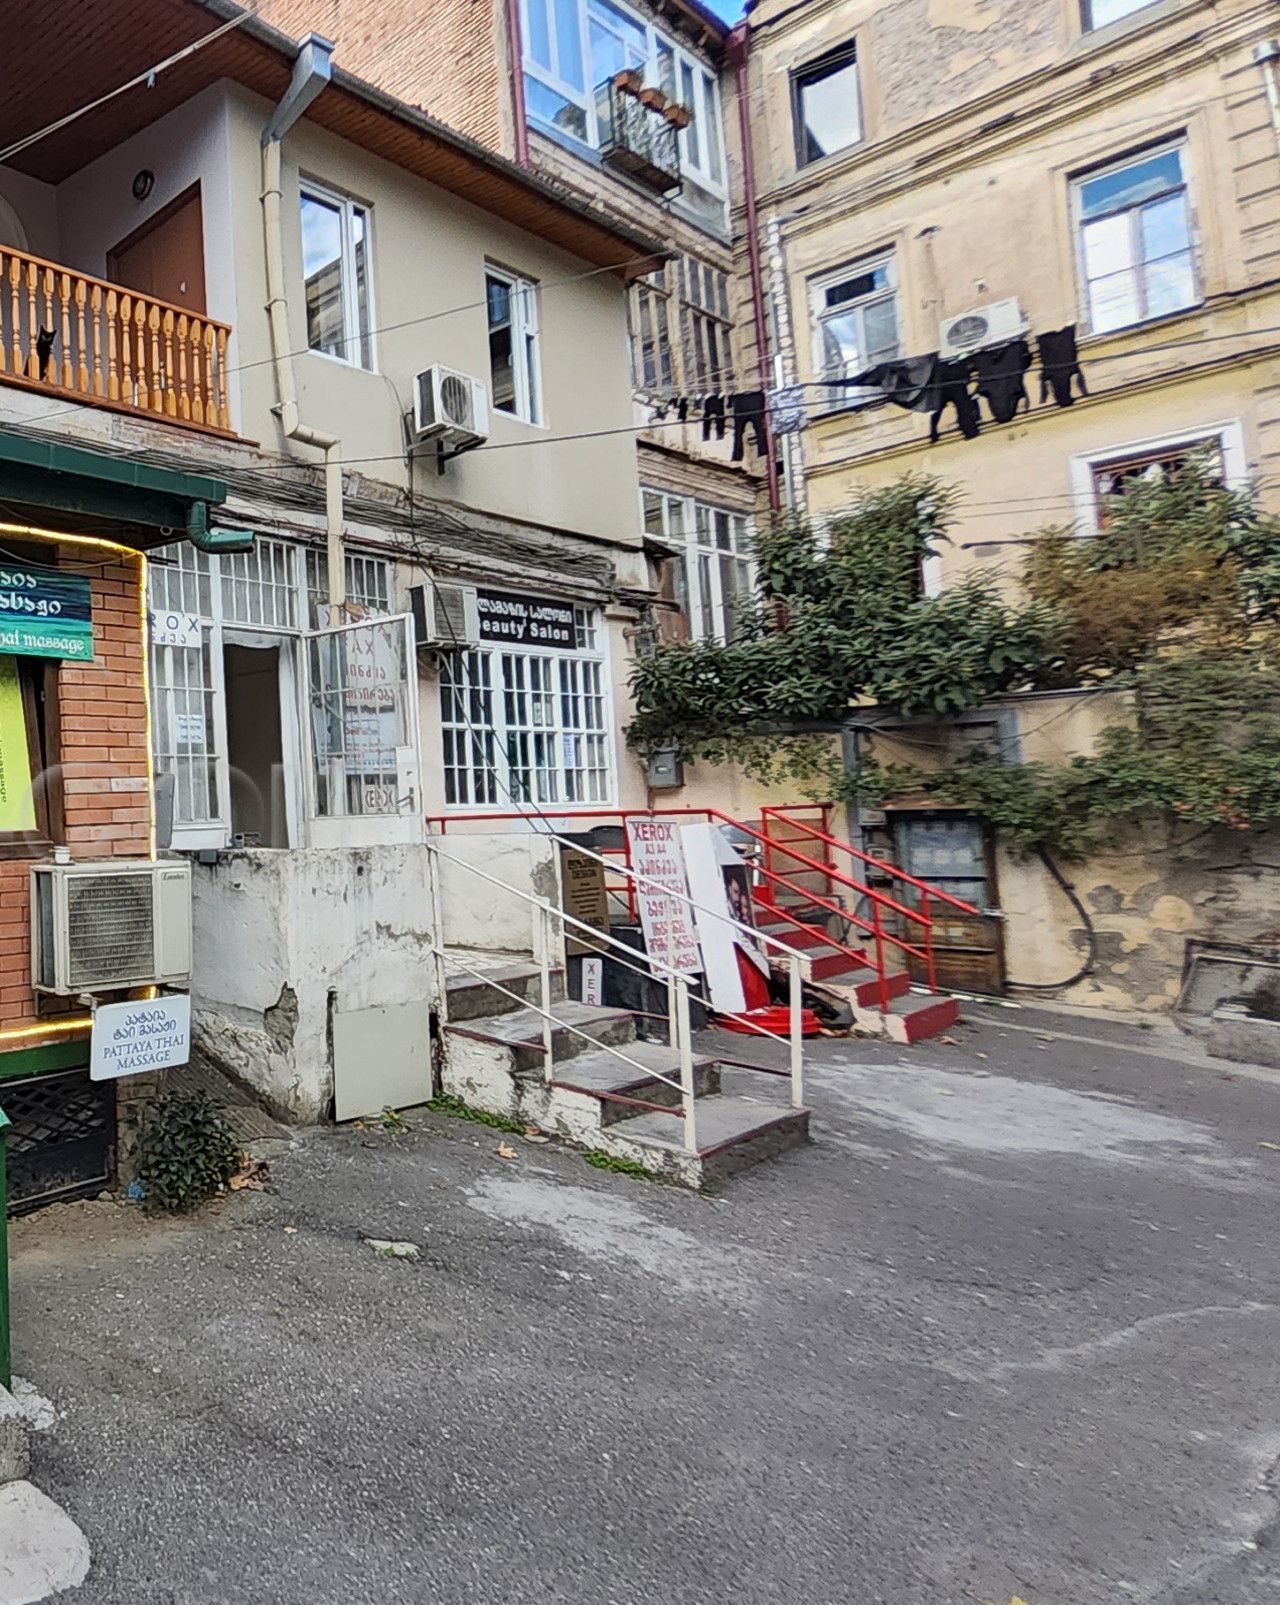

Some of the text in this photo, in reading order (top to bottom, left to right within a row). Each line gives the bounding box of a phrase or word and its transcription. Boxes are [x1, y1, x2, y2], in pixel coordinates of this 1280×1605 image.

[482, 619, 569, 640] eauty Salon
[22, 633, 85, 654] massage
[634, 822, 673, 841] XEROX
[125, 1009, 166, 1026] პატაია
[113, 1019, 177, 1041] ტაი მასაჟი
[103, 1034, 185, 1059] PATTAYA THAI
[116, 1049, 172, 1070] MASSAGE
